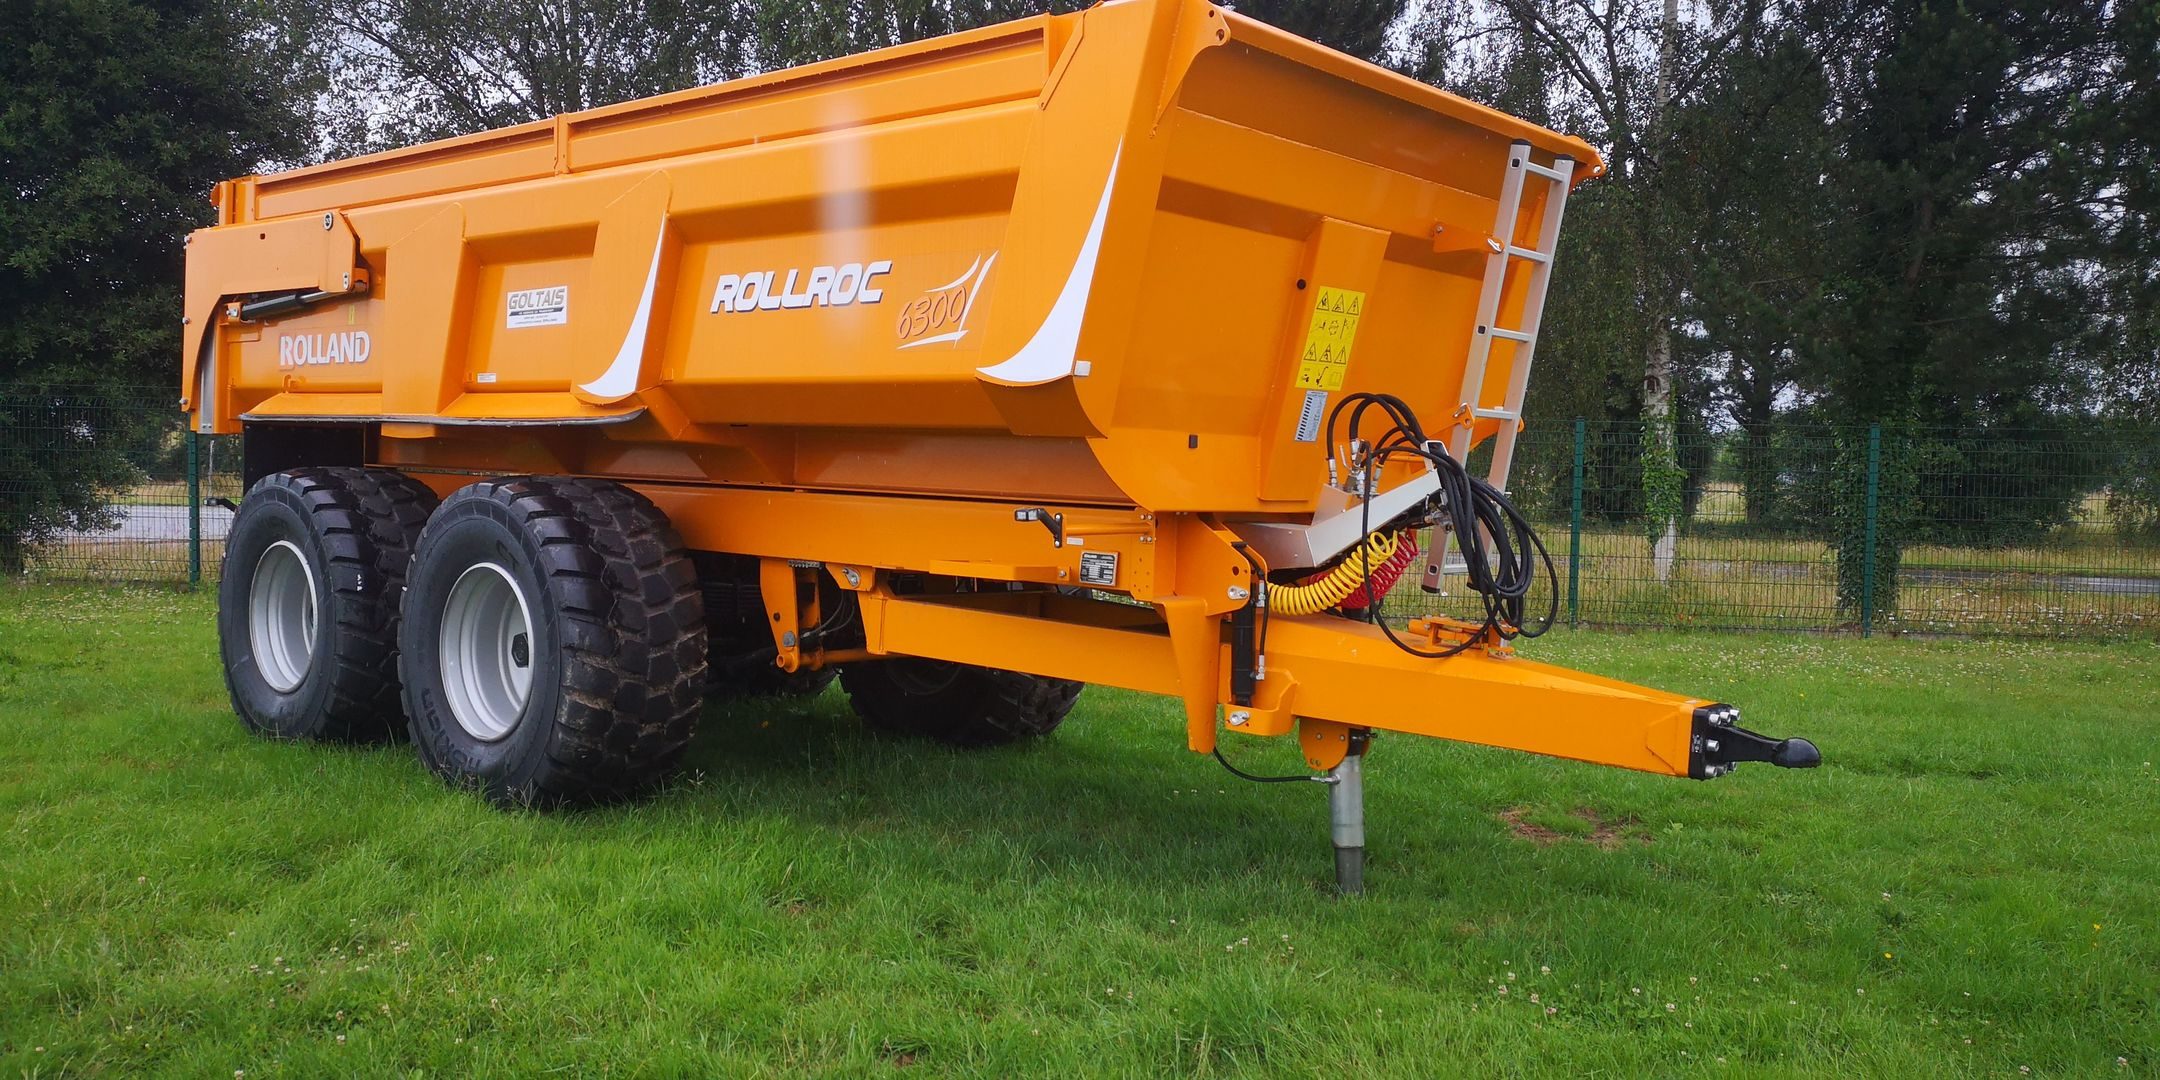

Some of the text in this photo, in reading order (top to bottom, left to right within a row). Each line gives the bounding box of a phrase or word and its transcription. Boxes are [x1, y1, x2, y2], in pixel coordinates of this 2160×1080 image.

[509, 288, 565, 309] GOLTAIS
[710, 260, 892, 314] ROLLROC
[896, 286, 967, 340] 6300
[280, 330, 370, 366] ROLLAND
